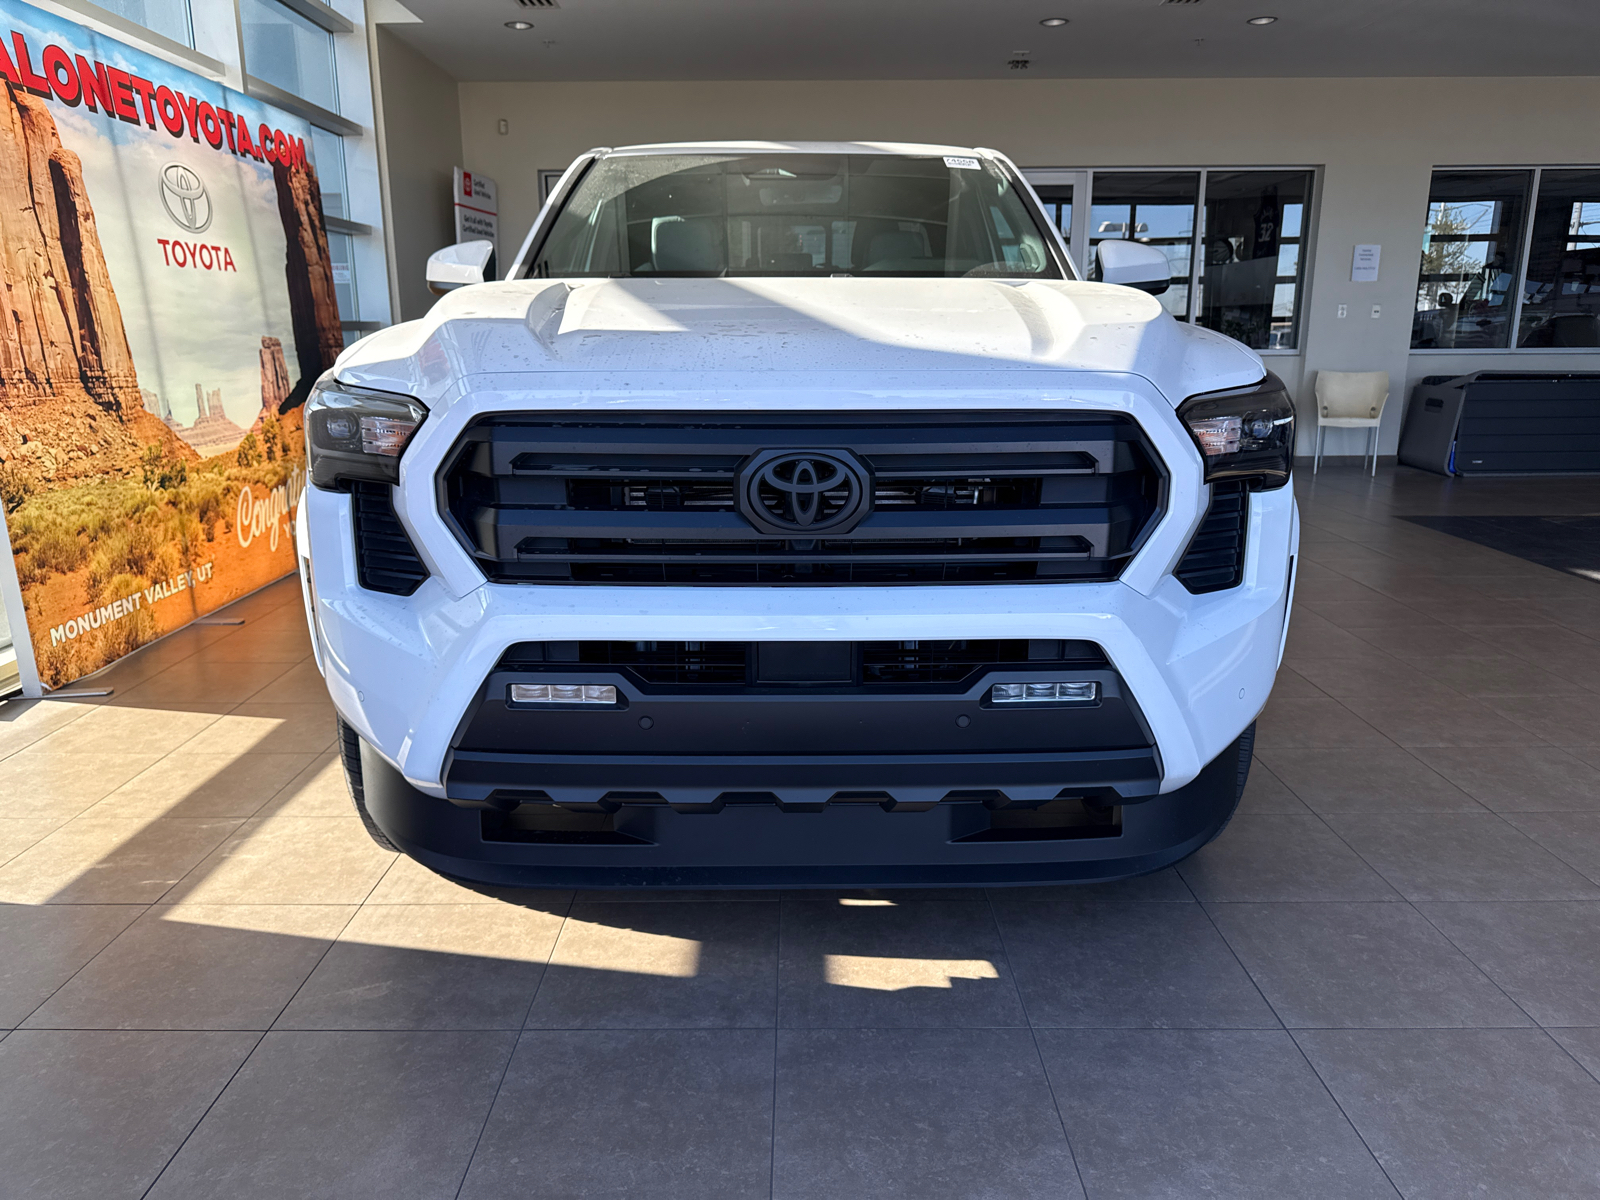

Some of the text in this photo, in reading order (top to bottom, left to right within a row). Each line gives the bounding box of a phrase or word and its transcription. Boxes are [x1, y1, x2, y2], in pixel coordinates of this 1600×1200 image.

[1258, 222, 1274, 242] 32
[157, 238, 237, 272] TOYOTA
[50, 562, 213, 647] MONUMENT VALLEY, UT
